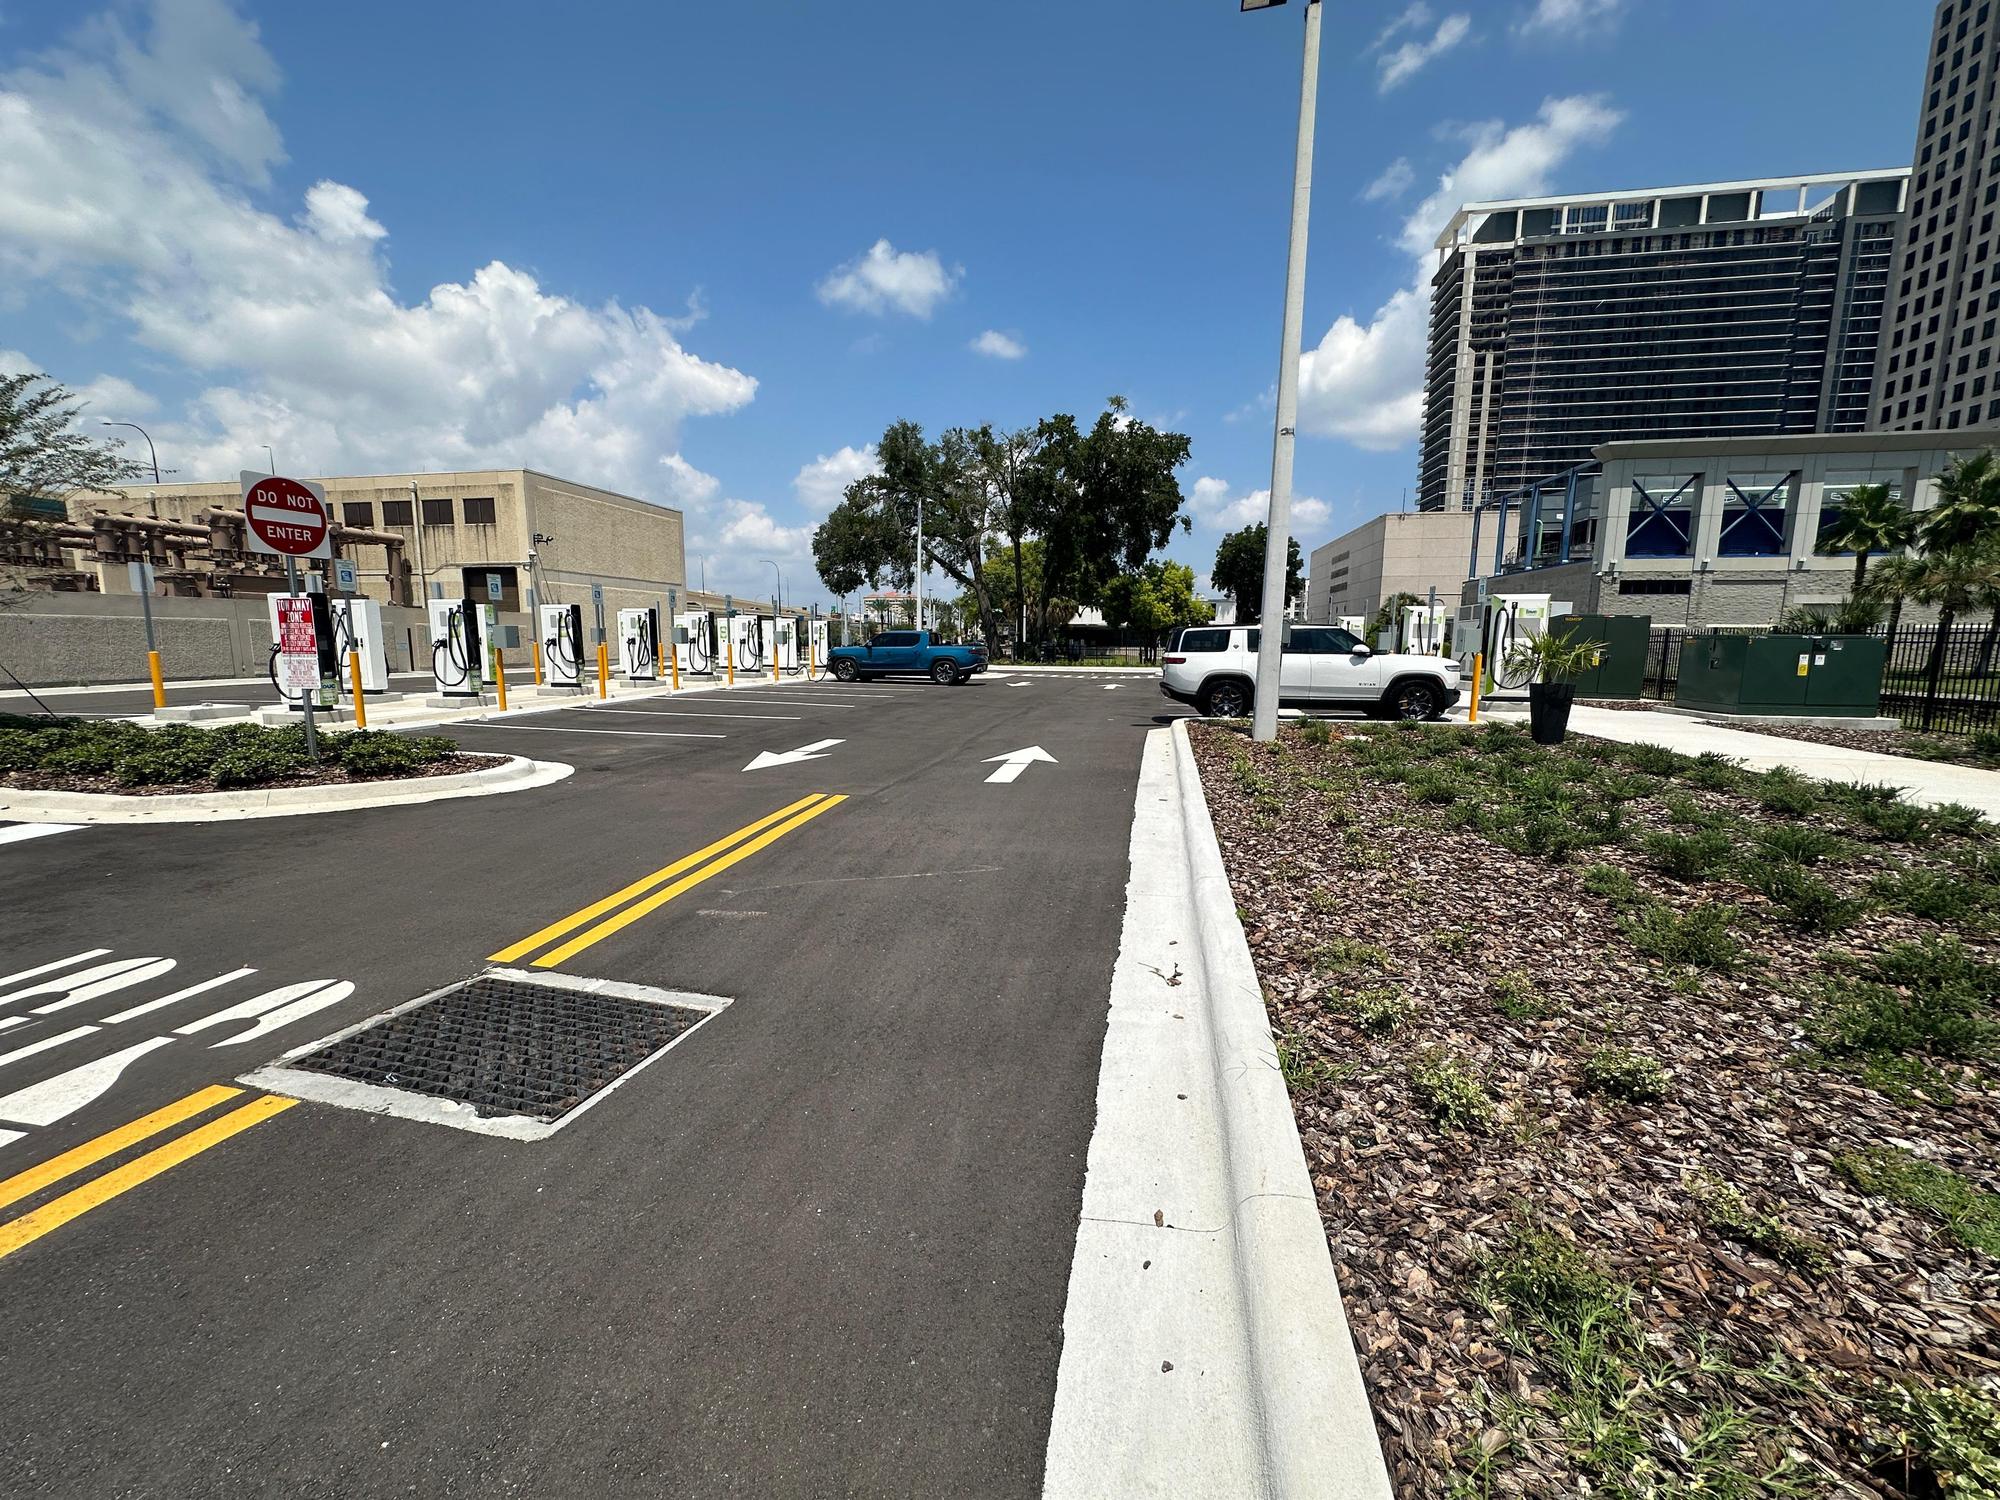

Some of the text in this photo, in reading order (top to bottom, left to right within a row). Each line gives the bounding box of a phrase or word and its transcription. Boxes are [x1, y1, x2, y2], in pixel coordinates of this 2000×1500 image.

[256, 489, 313, 509] DO NOT
[266, 525, 312, 542] ENTER
[277, 600, 310, 611] TOW AWAY
[286, 611, 304, 622] ZONE
